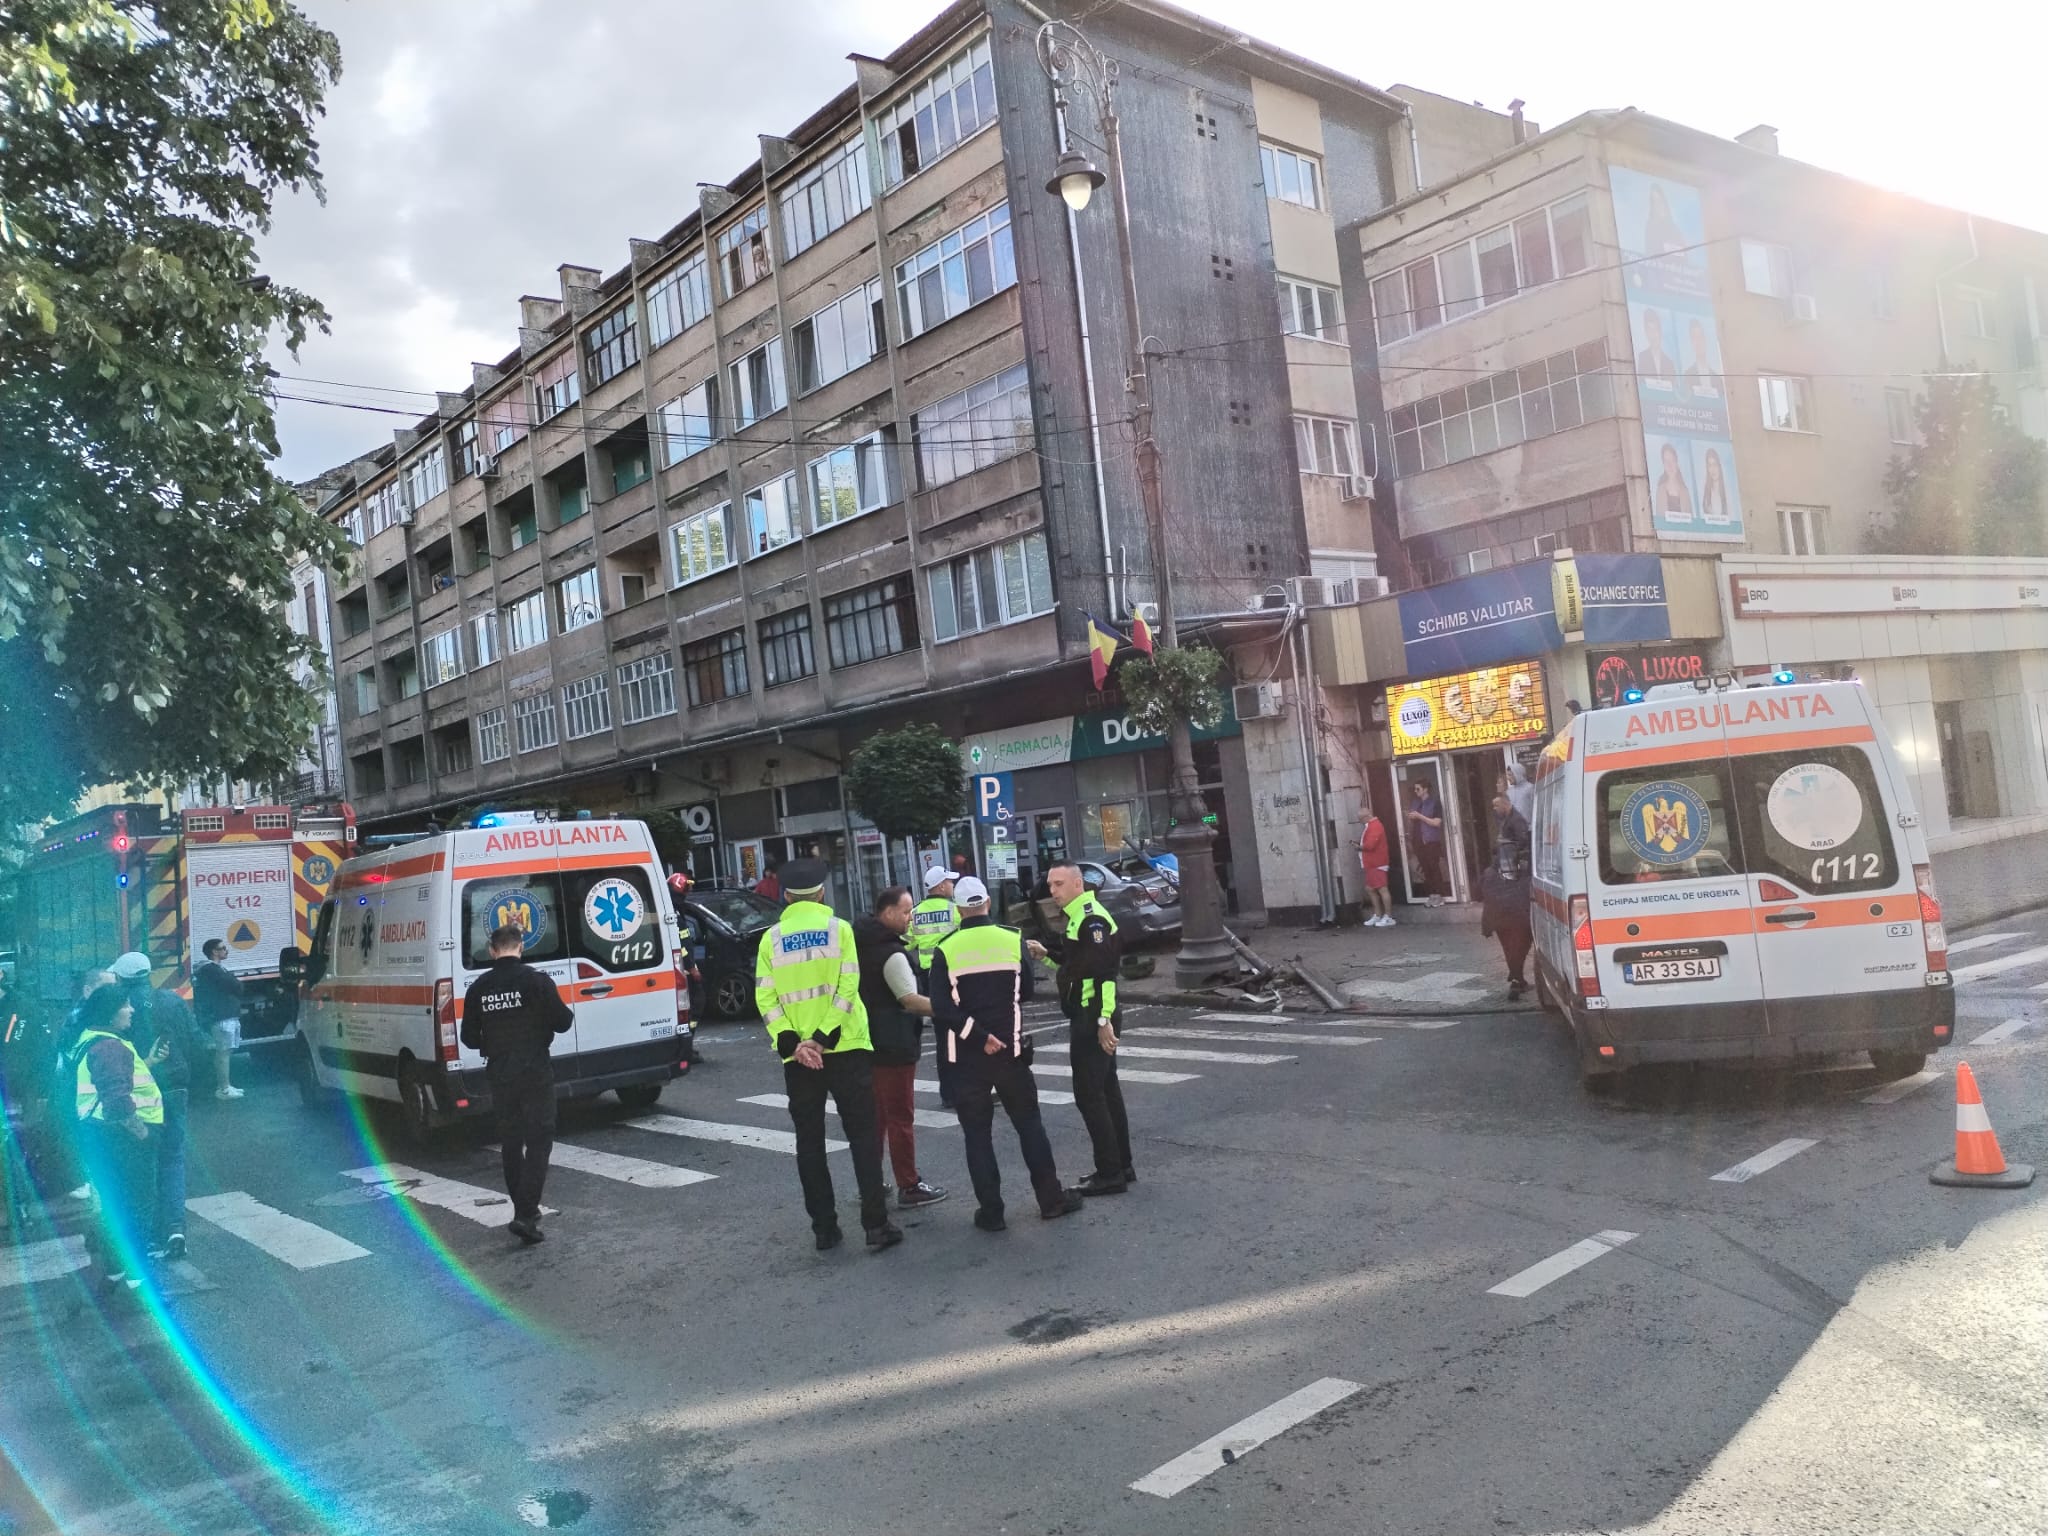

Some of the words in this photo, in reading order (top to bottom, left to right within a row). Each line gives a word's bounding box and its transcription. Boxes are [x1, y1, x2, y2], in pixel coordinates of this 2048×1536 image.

[1629, 585, 1660, 600] OFFICE
[1750, 590, 1769, 601] BRD
[1902, 589, 1918, 599] BRD
[1418, 610, 1468, 635] SCHIMB
[1471, 597, 1534, 623] VALUTAR
[1642, 656, 1703, 681] LUXOR
[1625, 693, 1834, 739] AMBULANTA
[1102, 717, 1162, 745] DO
[1395, 718, 1543, 749] luxor-exchange.ro
[999, 734, 1063, 756] FARMACIA
[980, 777, 1000, 817] P
[485, 825, 628, 852] AMBULANTA
[993, 826, 1008, 844] P
[1810, 838, 1834, 848] ARAD
[1826, 853, 1880, 881] 112
[194, 870, 286, 887] POMPIERII
[236, 895, 261, 908] 112
[1602, 896, 1639, 907] ECHIPAJ
[1641, 894, 1680, 903] MEDICAL
[1682, 892, 1694, 900] DE
[1698, 889, 1740, 899] URGENTA
[915, 911, 949, 924] POLITIA
[381, 920, 426, 943] AMBULANTA
[784, 932, 826, 945] POLITIA
[621, 941, 653, 962] 112
[1641, 948, 1699, 958] MASTER
[1635, 964, 1655, 980] AR
[1660, 963, 1680, 978] 33
[1684, 960, 1715, 975] SAJ
